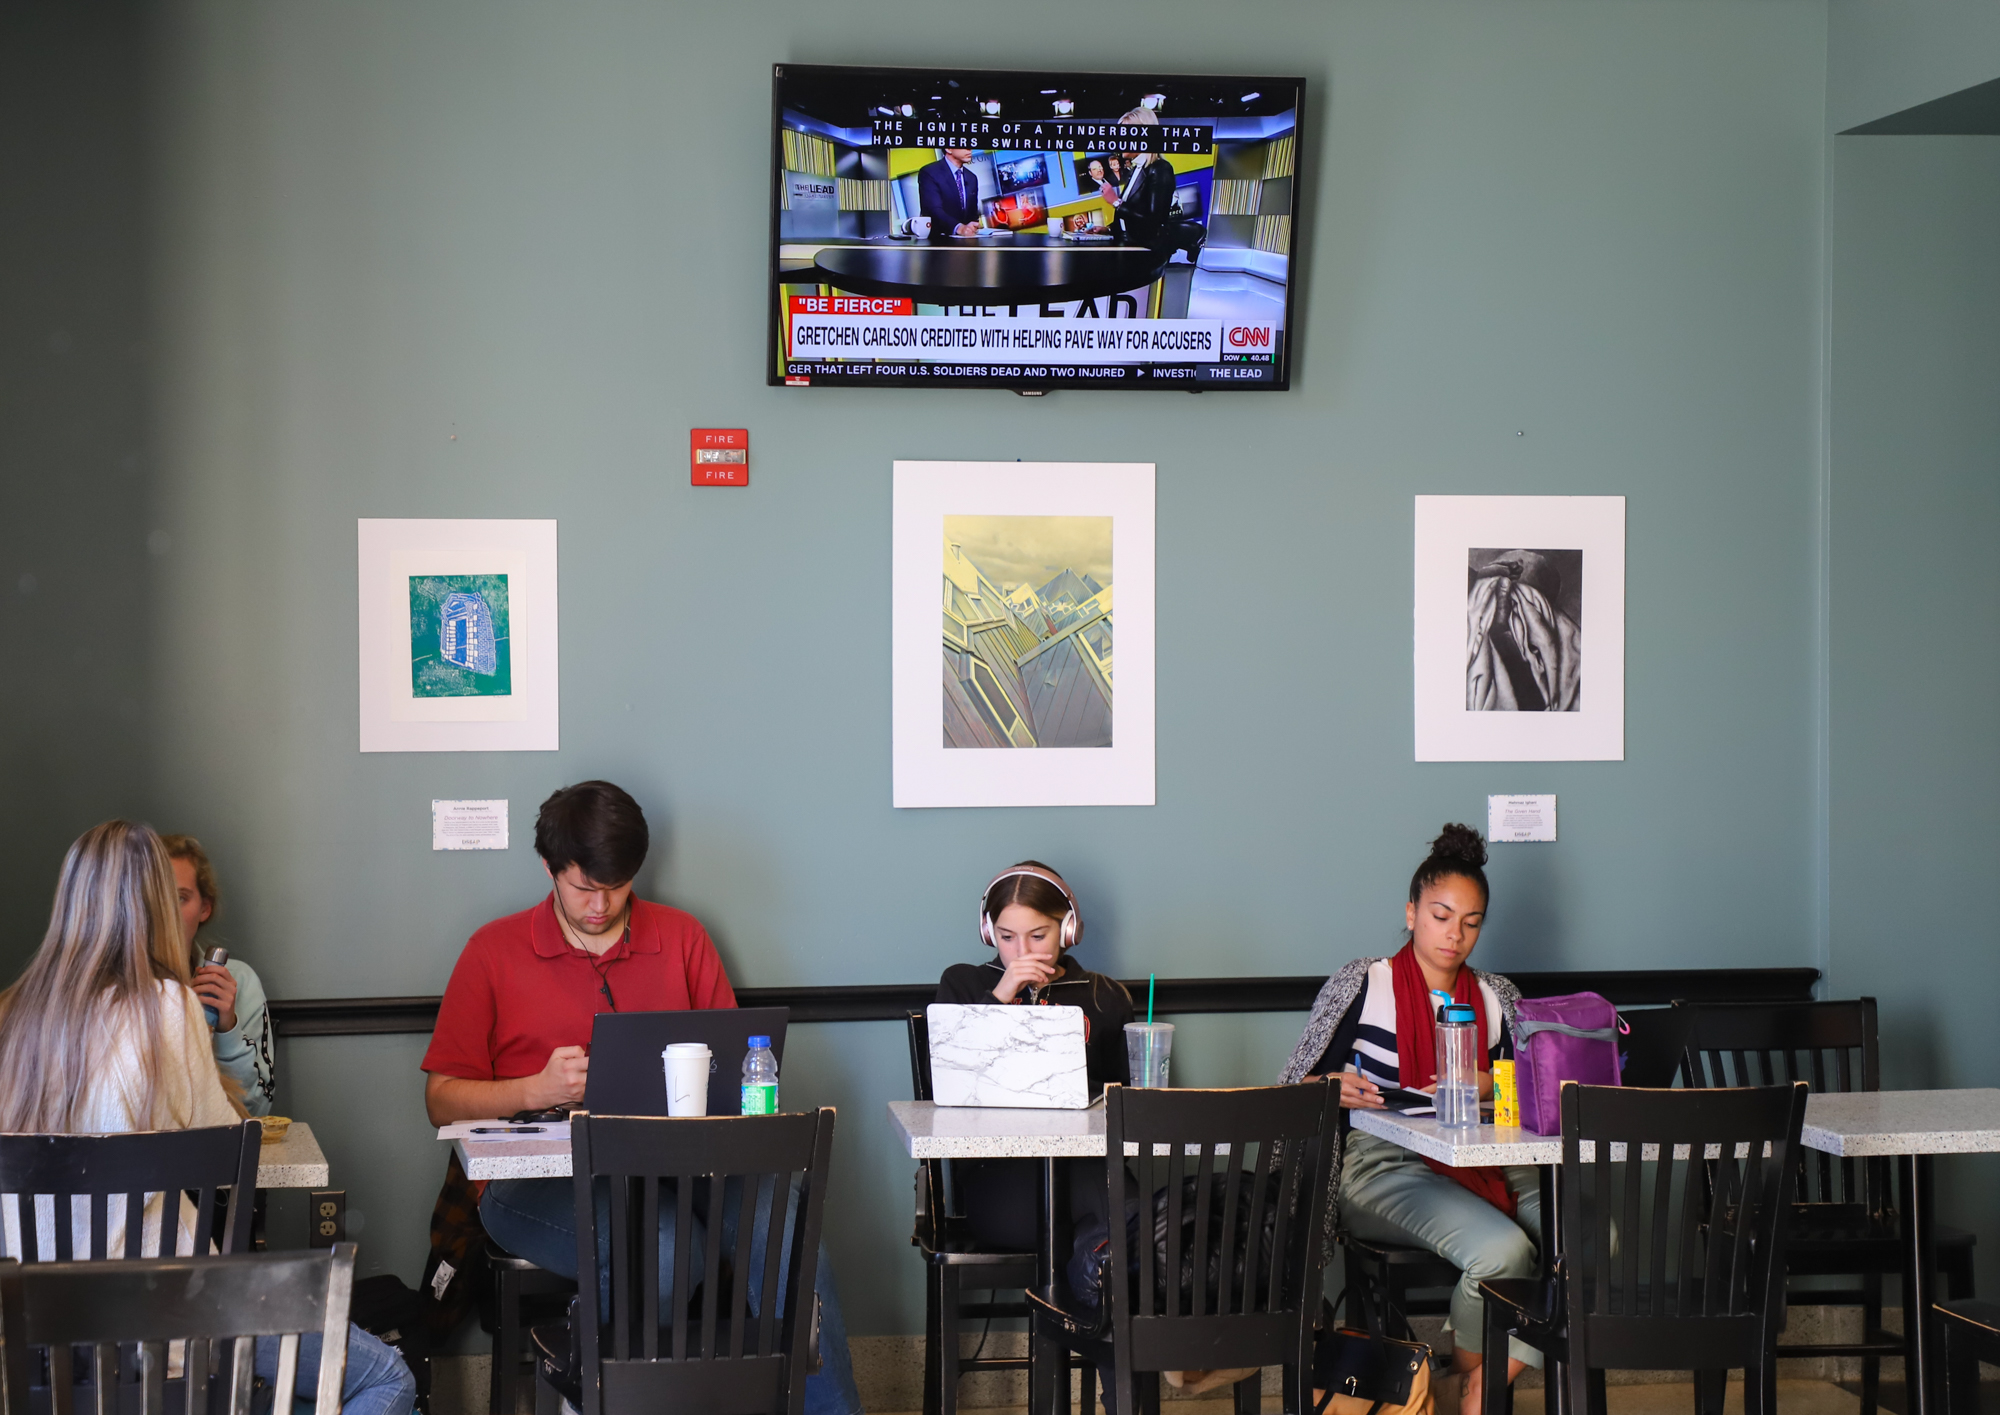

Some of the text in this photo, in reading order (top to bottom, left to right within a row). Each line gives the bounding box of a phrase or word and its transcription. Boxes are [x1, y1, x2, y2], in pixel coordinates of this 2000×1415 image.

[874, 121, 1201, 138] THE IGNITER OF A TINDERBOX THAT
[874, 136, 903, 146] HAD
[917, 136, 978, 147] EMBERS
[992, 138, 1074, 149] SWIRLING
[1087, 140, 1148, 151] AROUND
[1163, 142, 1179, 151] IT
[810, 184, 834, 194] LEAD
[798, 298, 901, 313] "BE FIERCE"
[797, 326, 1212, 350] GRETCHEN CARLSON CREDITED WITH HELPING PAVE WAY FOR ACCUSERS
[1229, 327, 1270, 347] CNN
[788, 364, 1196, 378] GER THAT LEFT FOUR U.S. SOLDIERS DEAD AND TWO INJURED INVESTI
[1210, 368, 1262, 378] THE LEAD
[706, 435, 734, 443] FIRE
